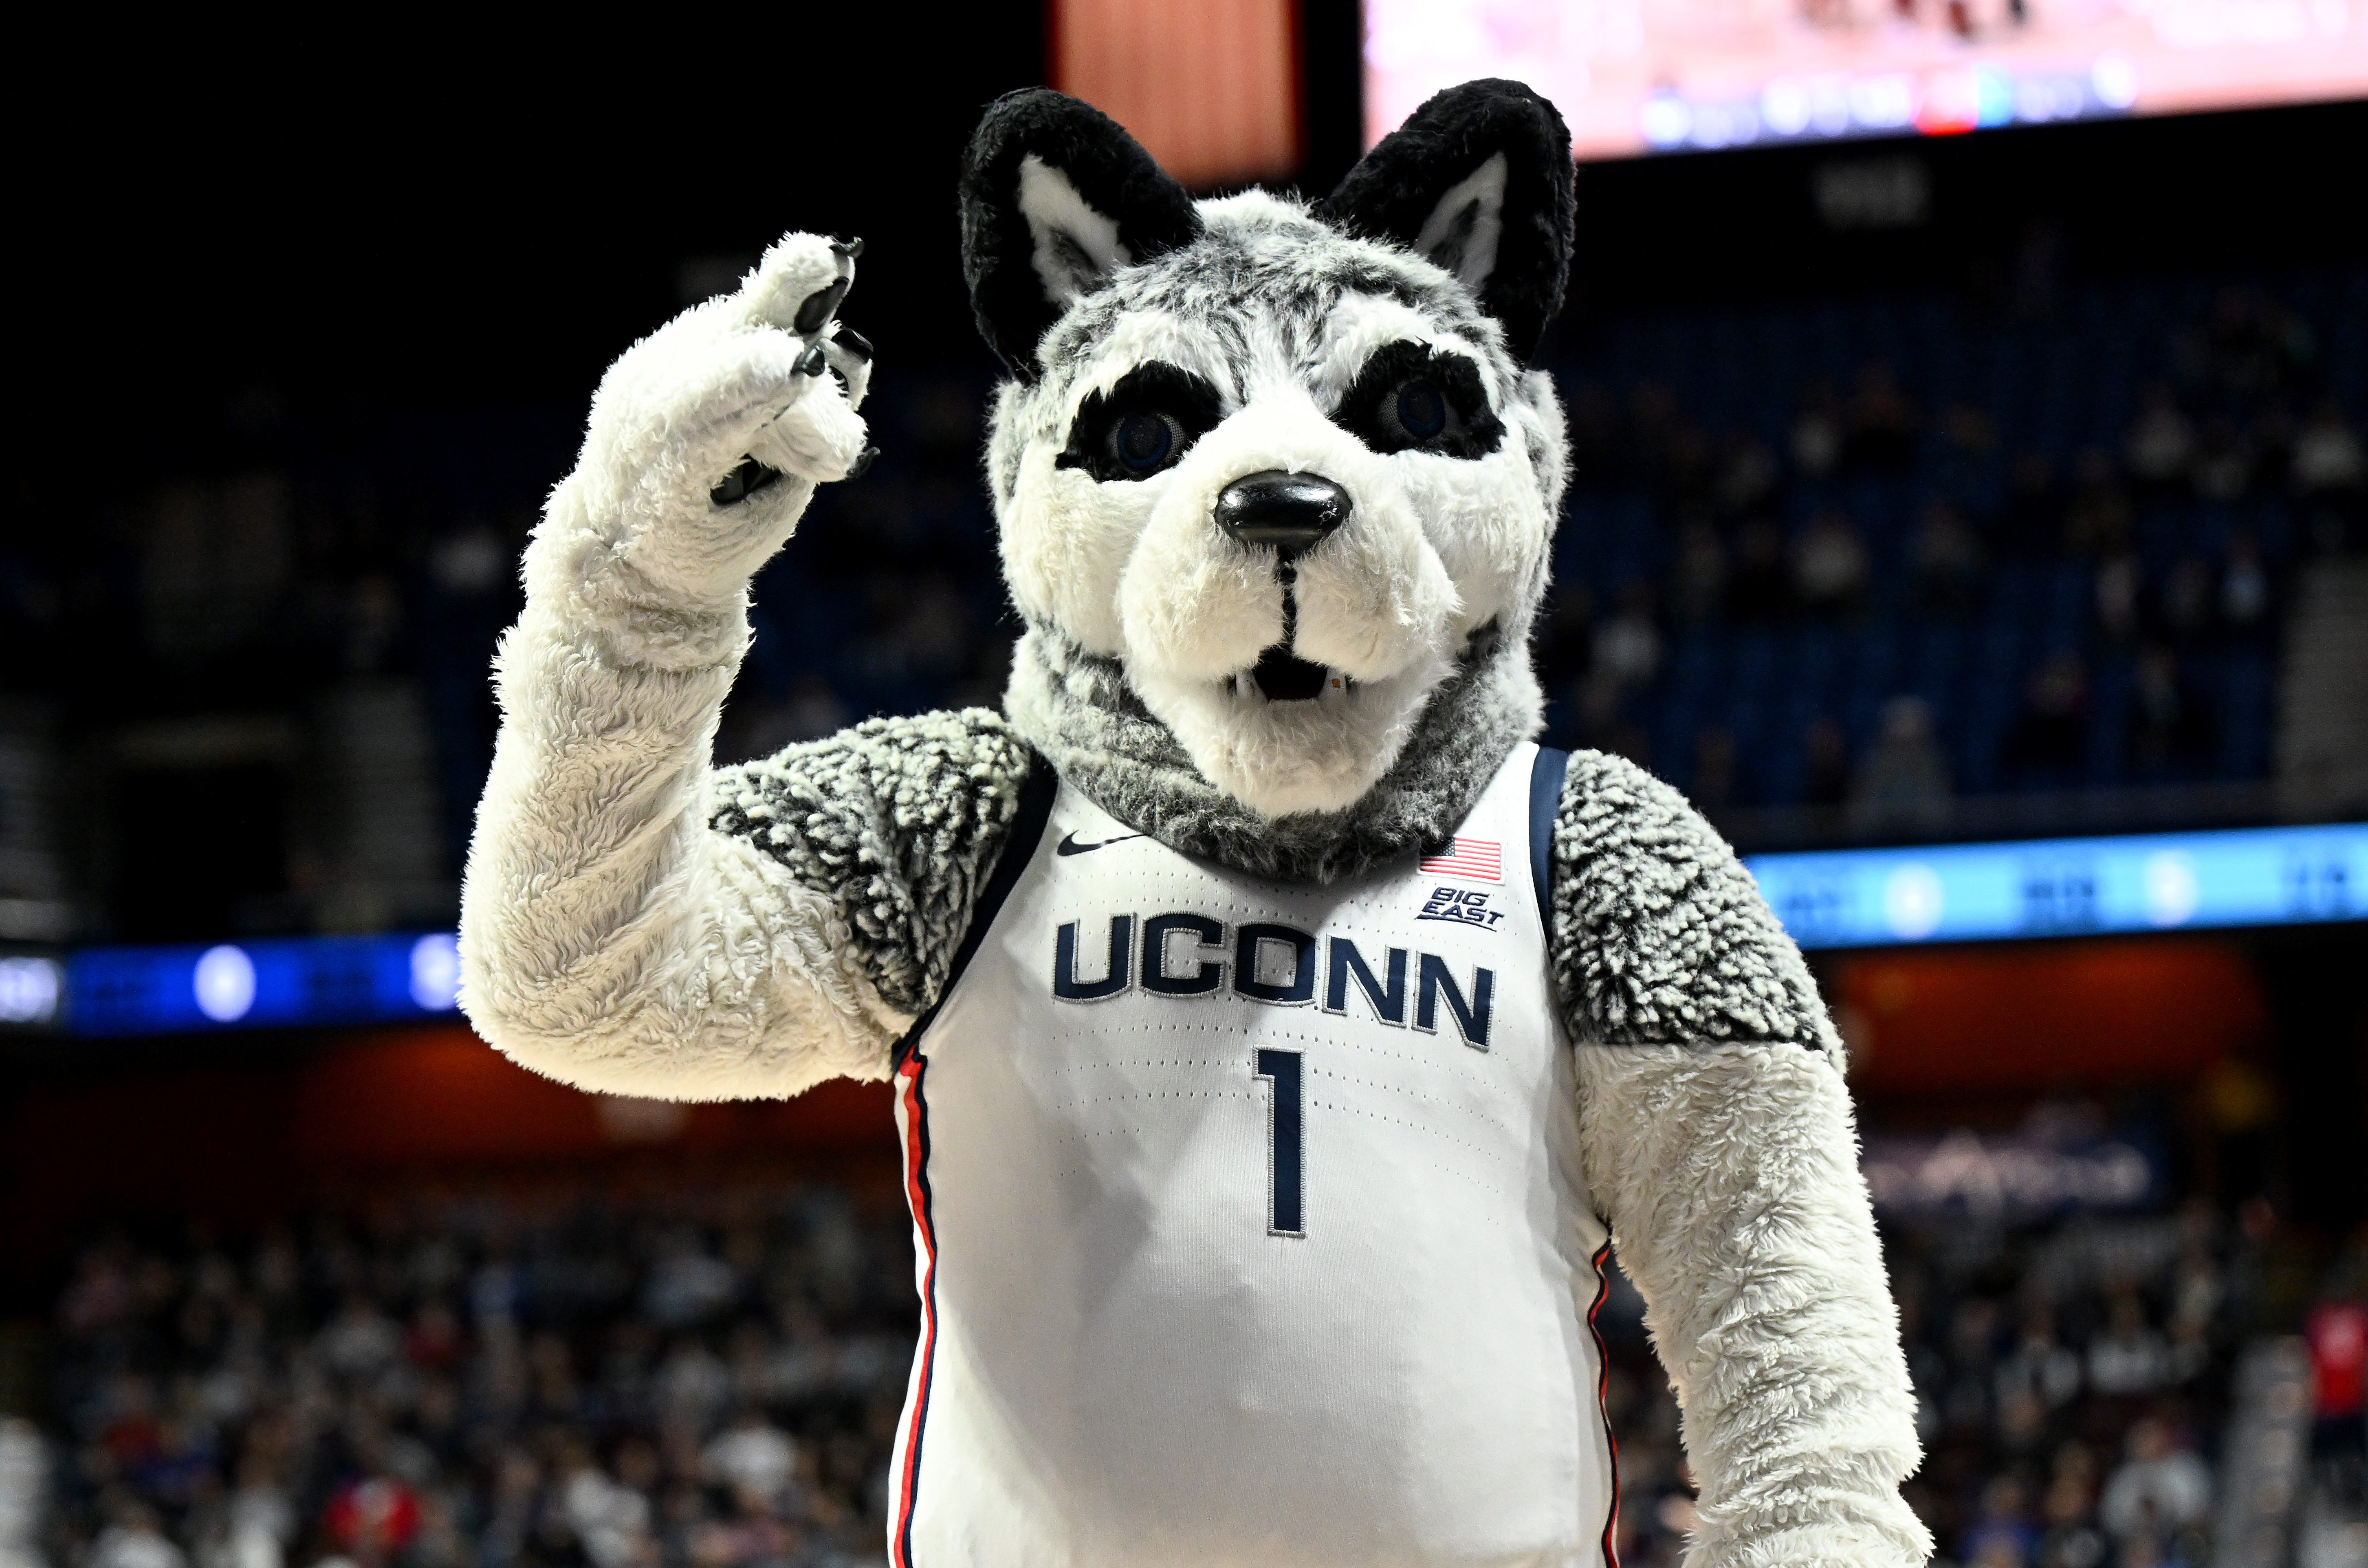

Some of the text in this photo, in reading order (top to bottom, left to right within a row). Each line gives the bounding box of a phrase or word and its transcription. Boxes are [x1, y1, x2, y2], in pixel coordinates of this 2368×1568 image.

[1422, 901, 1505, 924] EAST
[1431, 887, 1490, 906] BIG
[1052, 912, 1496, 1052] UCONN
[1252, 1045, 1306, 1238] 1
